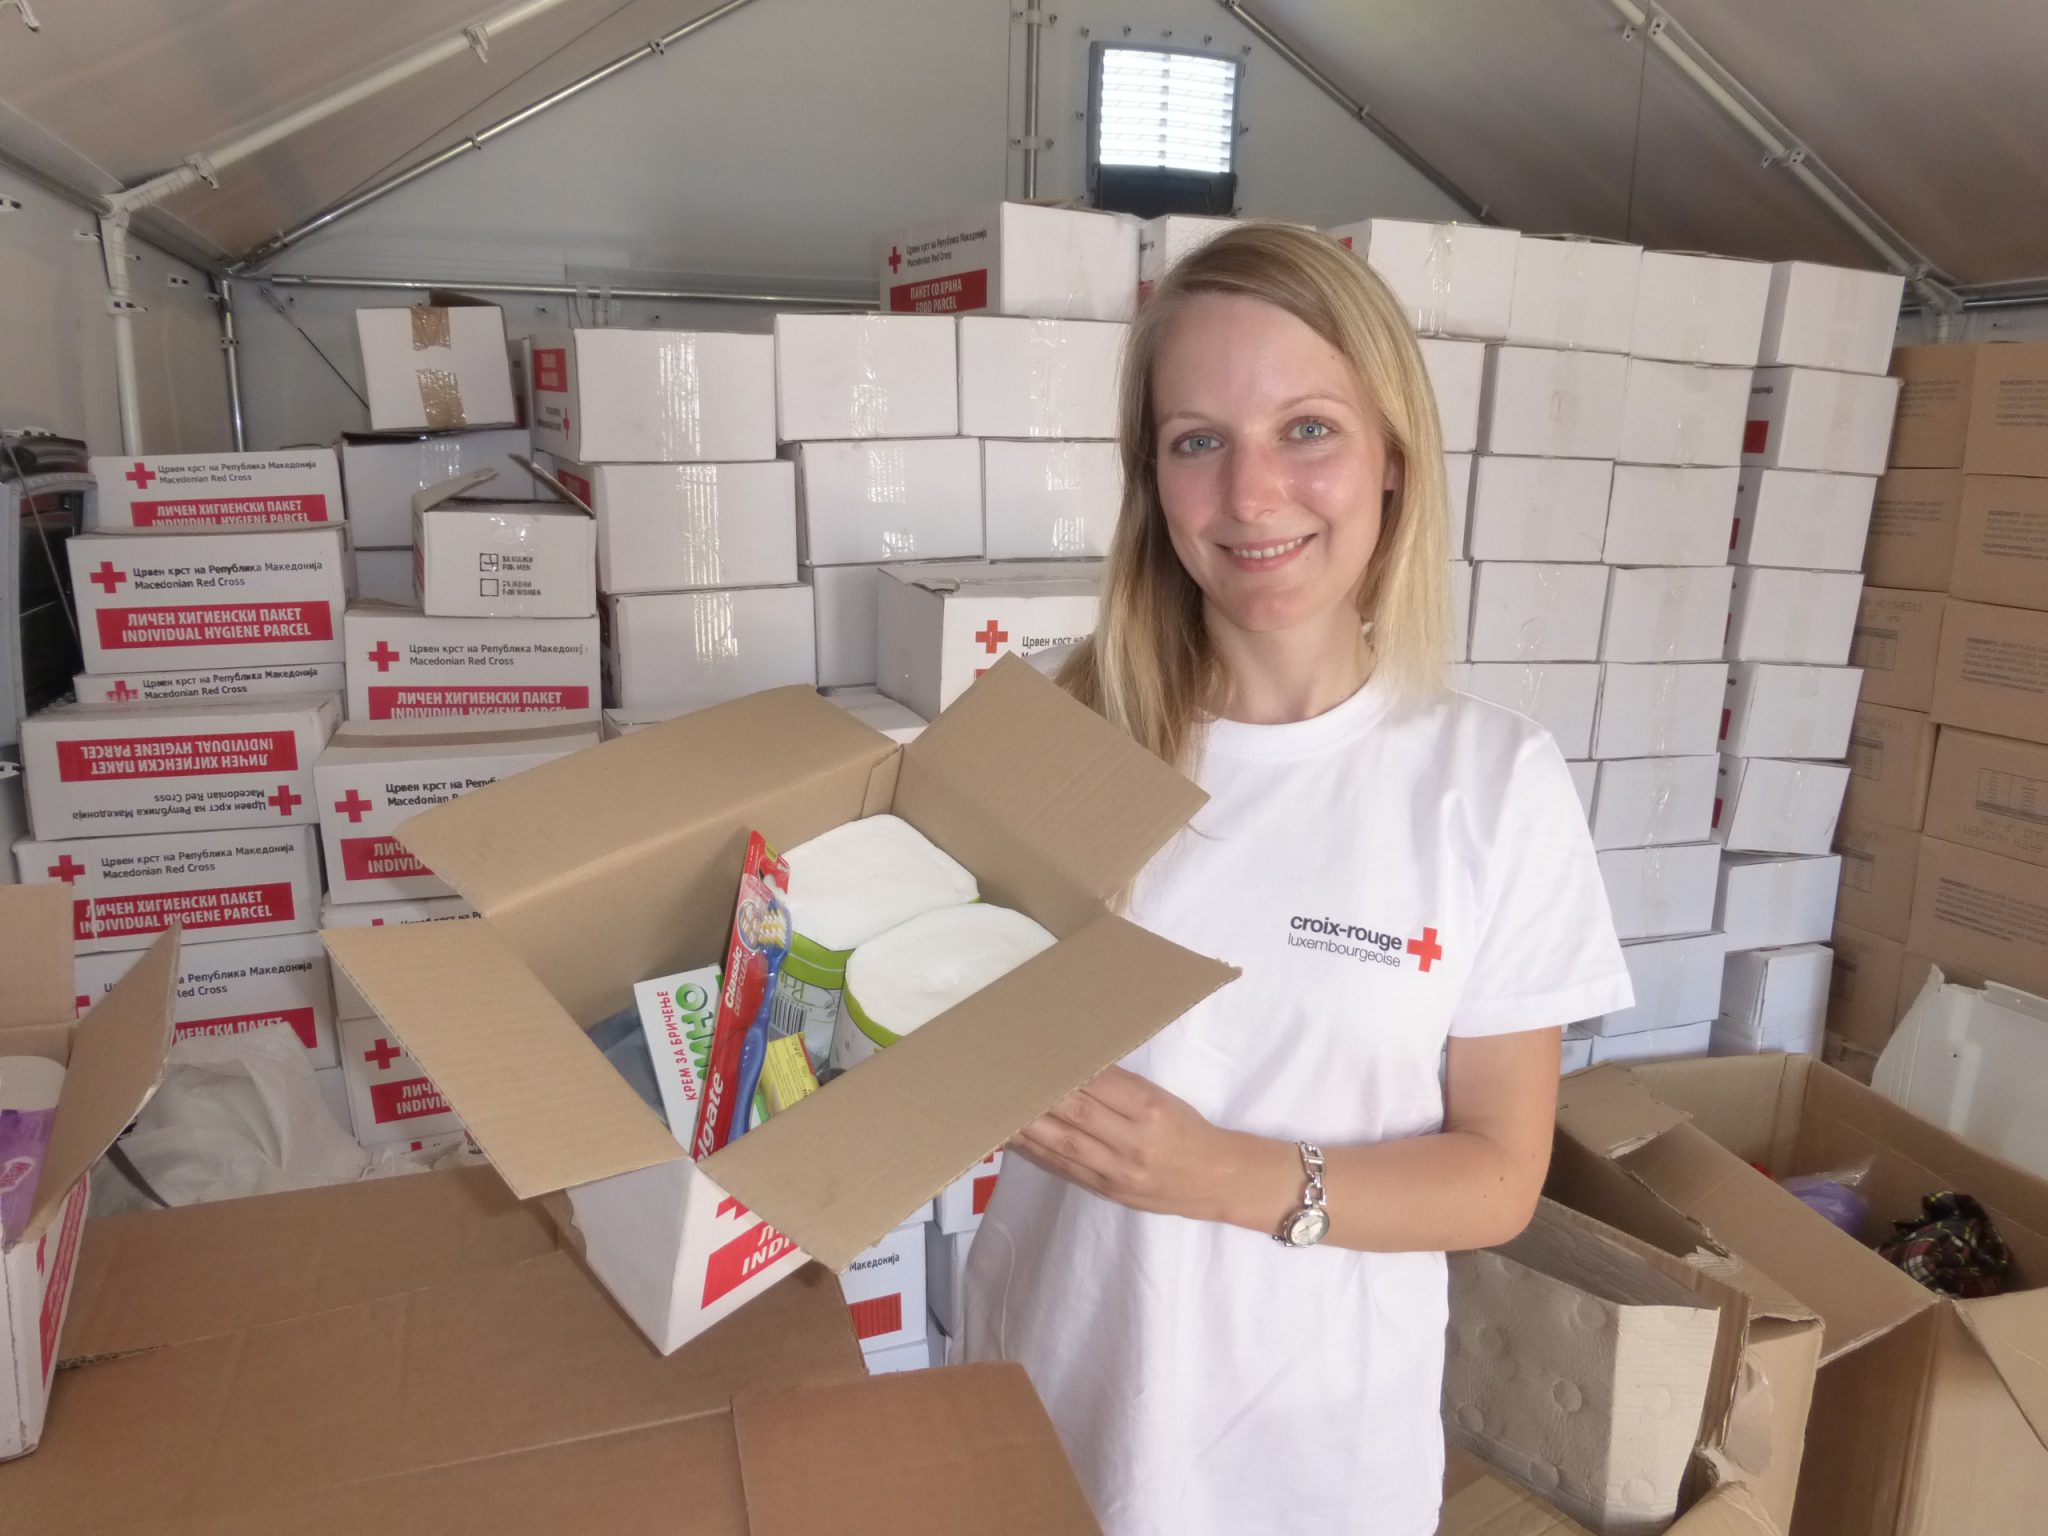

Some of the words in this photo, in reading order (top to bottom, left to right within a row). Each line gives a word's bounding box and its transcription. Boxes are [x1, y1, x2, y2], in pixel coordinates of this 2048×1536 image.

[910, 284, 930, 299] ПАКЕТ
[931, 282, 940, 295] СО
[940, 278, 962, 293] ХРАНА
[933, 296, 957, 311] PARCEL
[158, 464, 185, 474] Црвен
[188, 464, 206, 474] крст
[221, 462, 266, 472] Република
[268, 460, 316, 471] Македонија
[160, 475, 208, 485] Macedonian
[210, 474, 227, 482] Red
[229, 473, 252, 482] Cross
[156, 503, 196, 517] ЛИЧЕН
[199, 501, 266, 515] ХИГИЕНСКИ
[267, 500, 302, 512] ПАКЕТ
[132, 567, 165, 579] Црвен
[168, 567, 190, 577] крст
[194, 567, 206, 575] на
[209, 564, 262, 576] Република
[265, 561, 322, 573] Македонија
[135, 579, 193, 590] Macedonian
[196, 578, 215, 588] Red
[217, 577, 246, 587] Cross
[128, 612, 173, 627] ЛИЧЕН
[178, 609, 257, 625] ХИГИЕНСКИ
[260, 607, 302, 621] ПАКЕТ
[122, 628, 202, 644] INDIVIDUAL
[205, 625, 260, 641] HYGIENE
[263, 623, 312, 638] PARCEL
[409, 645, 440, 655] Црвен
[443, 645, 464, 655] крст
[467, 645, 478, 653] на
[481, 645, 531, 655] Република
[1022, 636, 1050, 648] Црвен
[410, 657, 465, 666] Macedonian
[468, 657, 486, 666] Red
[489, 657, 514, 666] Cross
[143, 678, 172, 690] Црвен
[175, 677, 197, 688] крст
[199, 677, 210, 685] на
[213, 672, 262, 684] Република
[265, 668, 318, 680] Македонија
[144, 689, 199, 700] Macedonian
[201, 687, 219, 696] Red
[221, 685, 247, 695] Cross
[397, 692, 441, 705] ЛИЧЕН
[445, 692, 519, 705] ХИГИЕНСКИ
[522, 691, 562, 704] ПАКЕТ
[80, 744, 131, 759] PARCEL
[135, 740, 193, 756] HYGIENE
[196, 738, 273, 754] INDIVIDUAL
[91, 760, 135, 775] ПАКЕТ
[138, 755, 219, 773] ХИГИЕНСКИ
[222, 753, 269, 768] ЛИЧЕН
[206, 789, 265, 801] Macedonian
[386, 783, 420, 794] Црвен
[423, 782, 447, 793] крст
[450, 781, 462, 789] на
[154, 792, 183, 803] Cross
[185, 791, 204, 801] Red
[388, 795, 449, 807] Macedonian
[72, 807, 134, 820] Македонија
[136, 804, 191, 818] Република
[193, 804, 206, 813] на
[208, 802, 233, 813] крст
[234, 800, 266, 812] Црвен
[101, 857, 134, 869] Црвен
[137, 855, 160, 866] крст
[163, 854, 176, 863] на
[178, 849, 233, 863] Република
[235, 844, 294, 858] Македонија
[374, 842, 407, 857] ЛИЧ
[103, 867, 163, 880] Macedonian
[165, 866, 185, 875] Red
[187, 862, 216, 873] Cross
[368, 857, 427, 874] INDIVID
[85, 901, 134, 918] ЛИЧЕН
[136, 894, 217, 914] ХИГИЕНСКИ
[220, 890, 263, 906] ПАКЕТ
[79, 915, 160, 934] INDIVIDUAL
[224, 905, 272, 920] PARCEL
[1290, 915, 1403, 951] croix-rouge
[1288, 933, 1401, 968] luxembourgeoise
[188, 968, 247, 985] Република
[249, 961, 312, 977] Македонија
[725, 945, 743, 1008] Classic
[738, 951, 752, 986] CLEAN
[197, 984, 228, 996] Cross
[733, 986, 745, 1017] DEEP
[656, 990, 682, 1046] БРИЧЕЊЕ
[176, 1021, 234, 1041] ИЕНСКИ
[674, 1049, 688, 1065] ЗА
[403, 1082, 438, 1099] ЛИЧ
[679, 1067, 698, 1101] КРЕМ
[695, 1071, 724, 1161] lgate
[849, 1252, 900, 1272] Македонија
